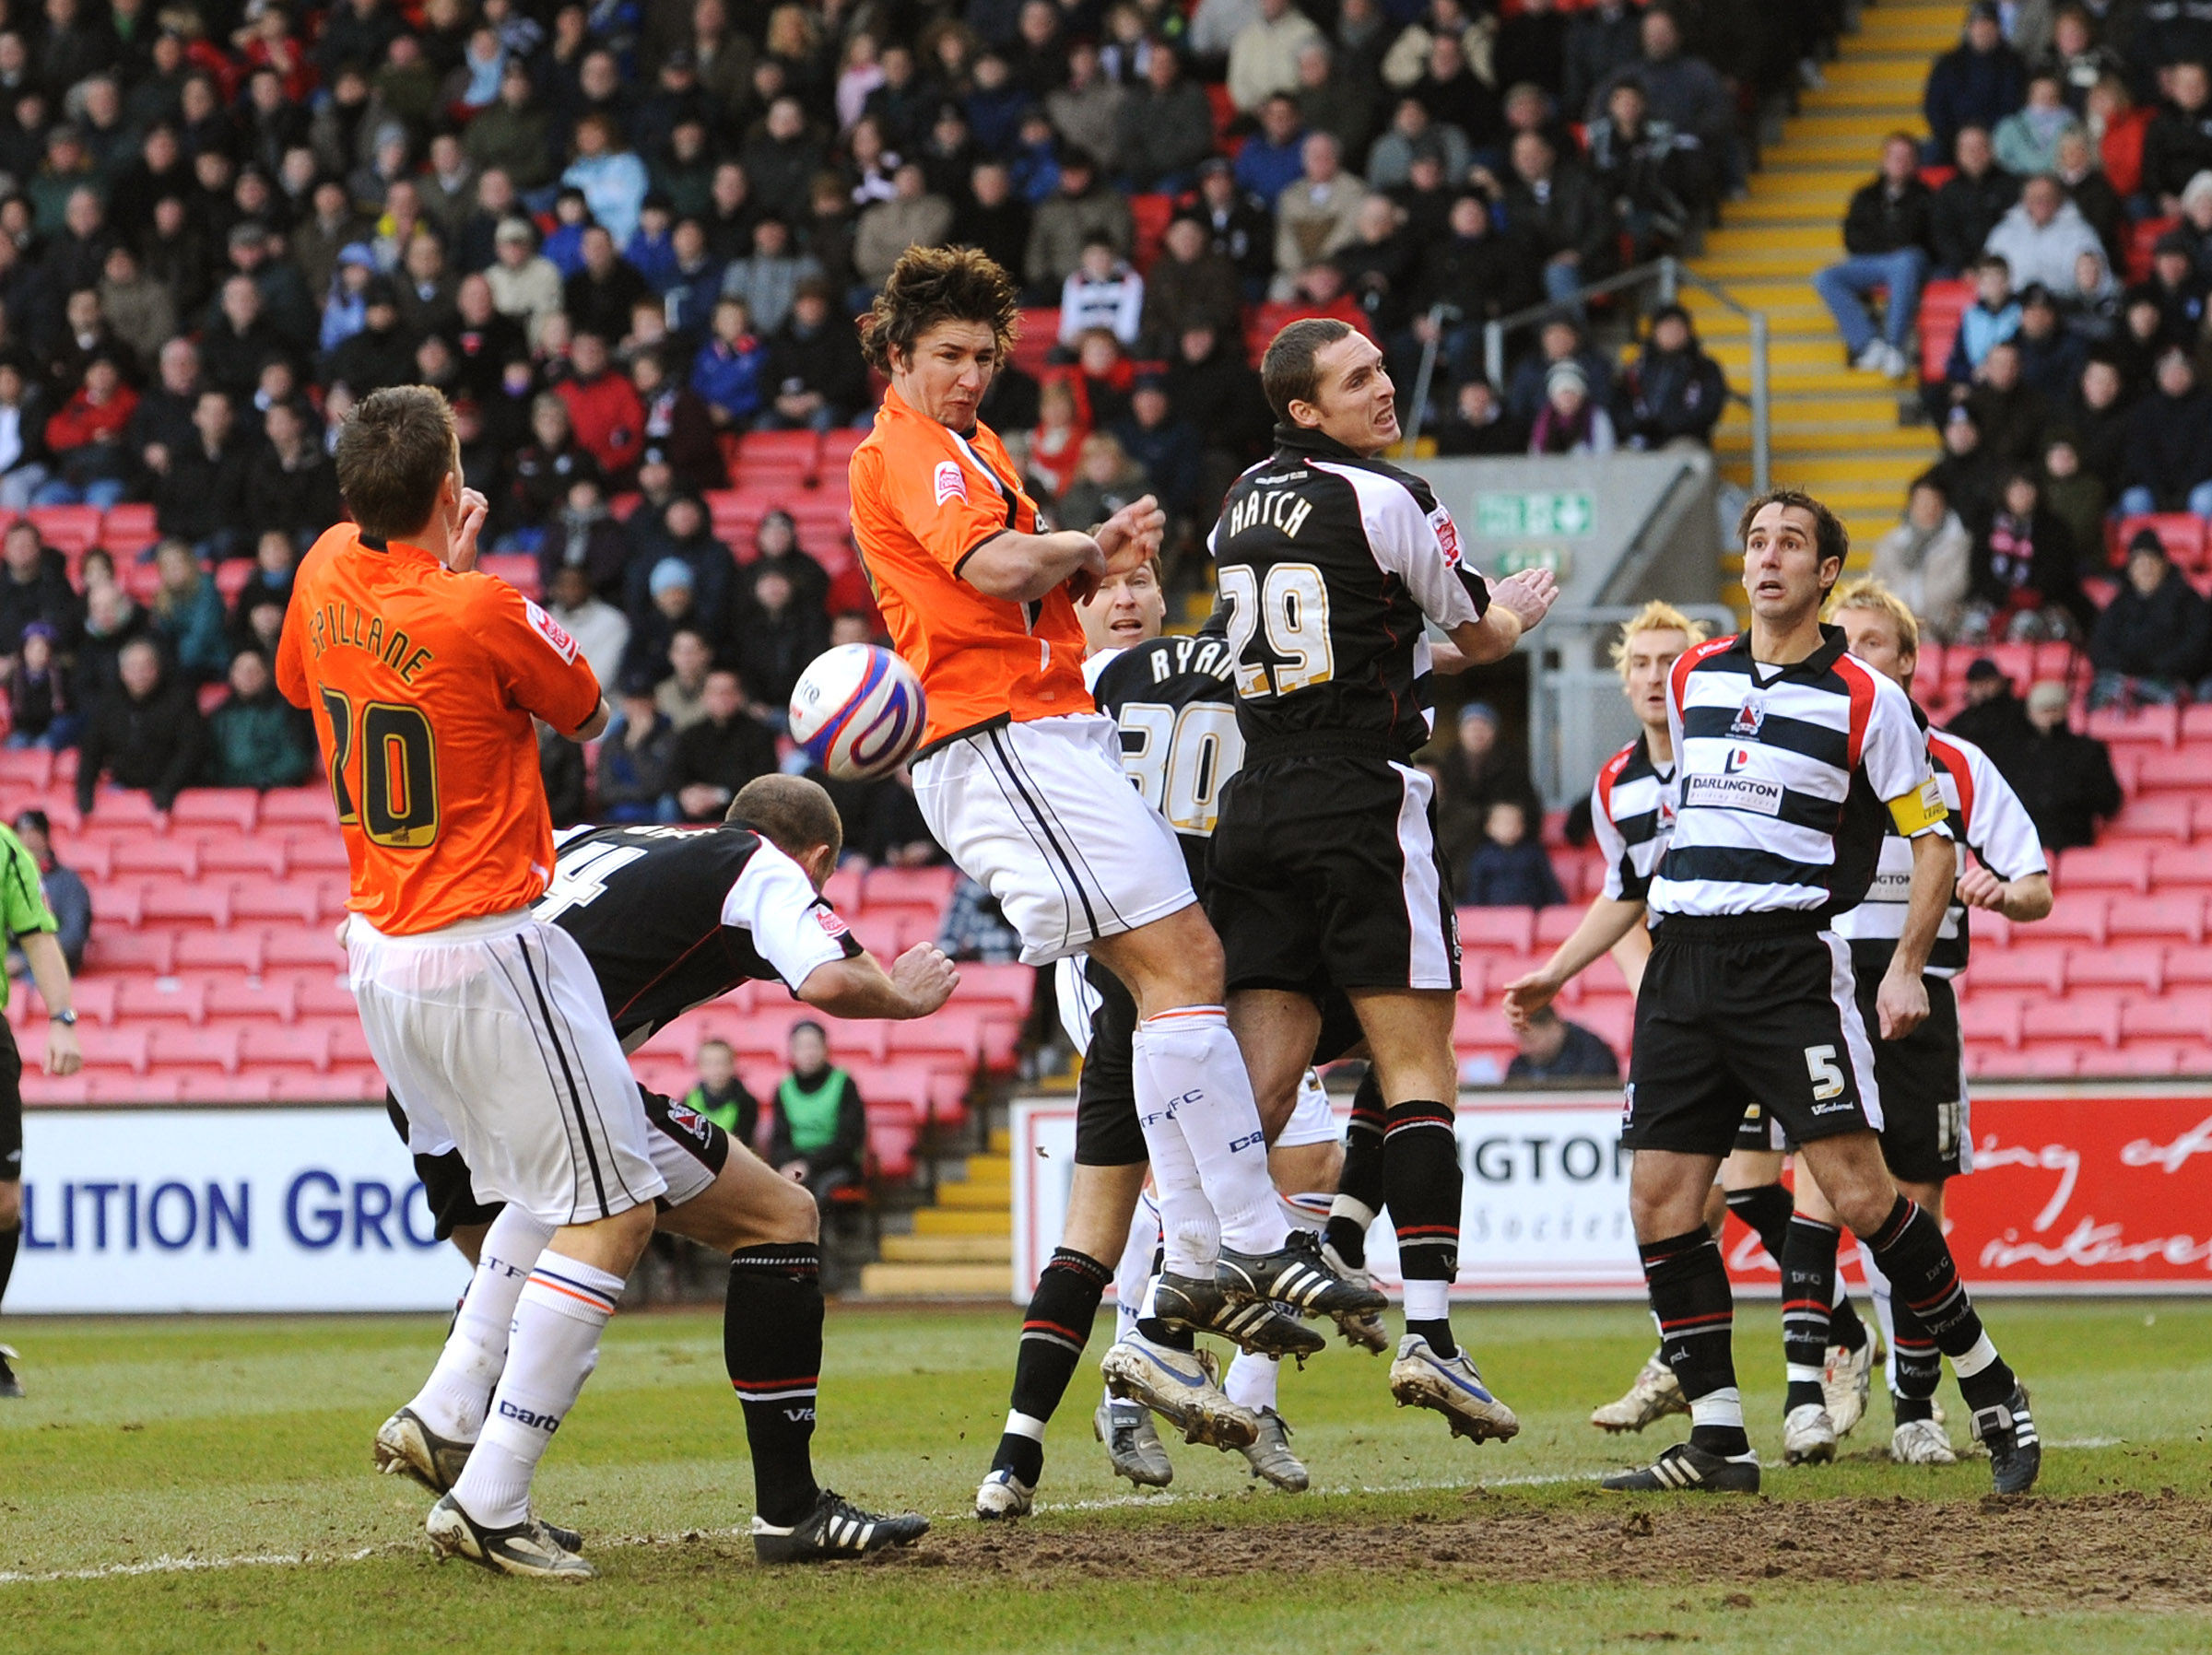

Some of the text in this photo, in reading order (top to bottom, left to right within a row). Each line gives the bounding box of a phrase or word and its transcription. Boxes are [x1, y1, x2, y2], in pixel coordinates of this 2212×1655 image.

[1230, 490, 1313, 539] HATCH
[1218, 562, 1335, 699] 29
[1118, 700, 1246, 838] 30
[1692, 778, 1779, 798] DARLINGTON
[1804, 1044, 1844, 1101] 5
[20, 1170, 440, 1251] LITION GRO
